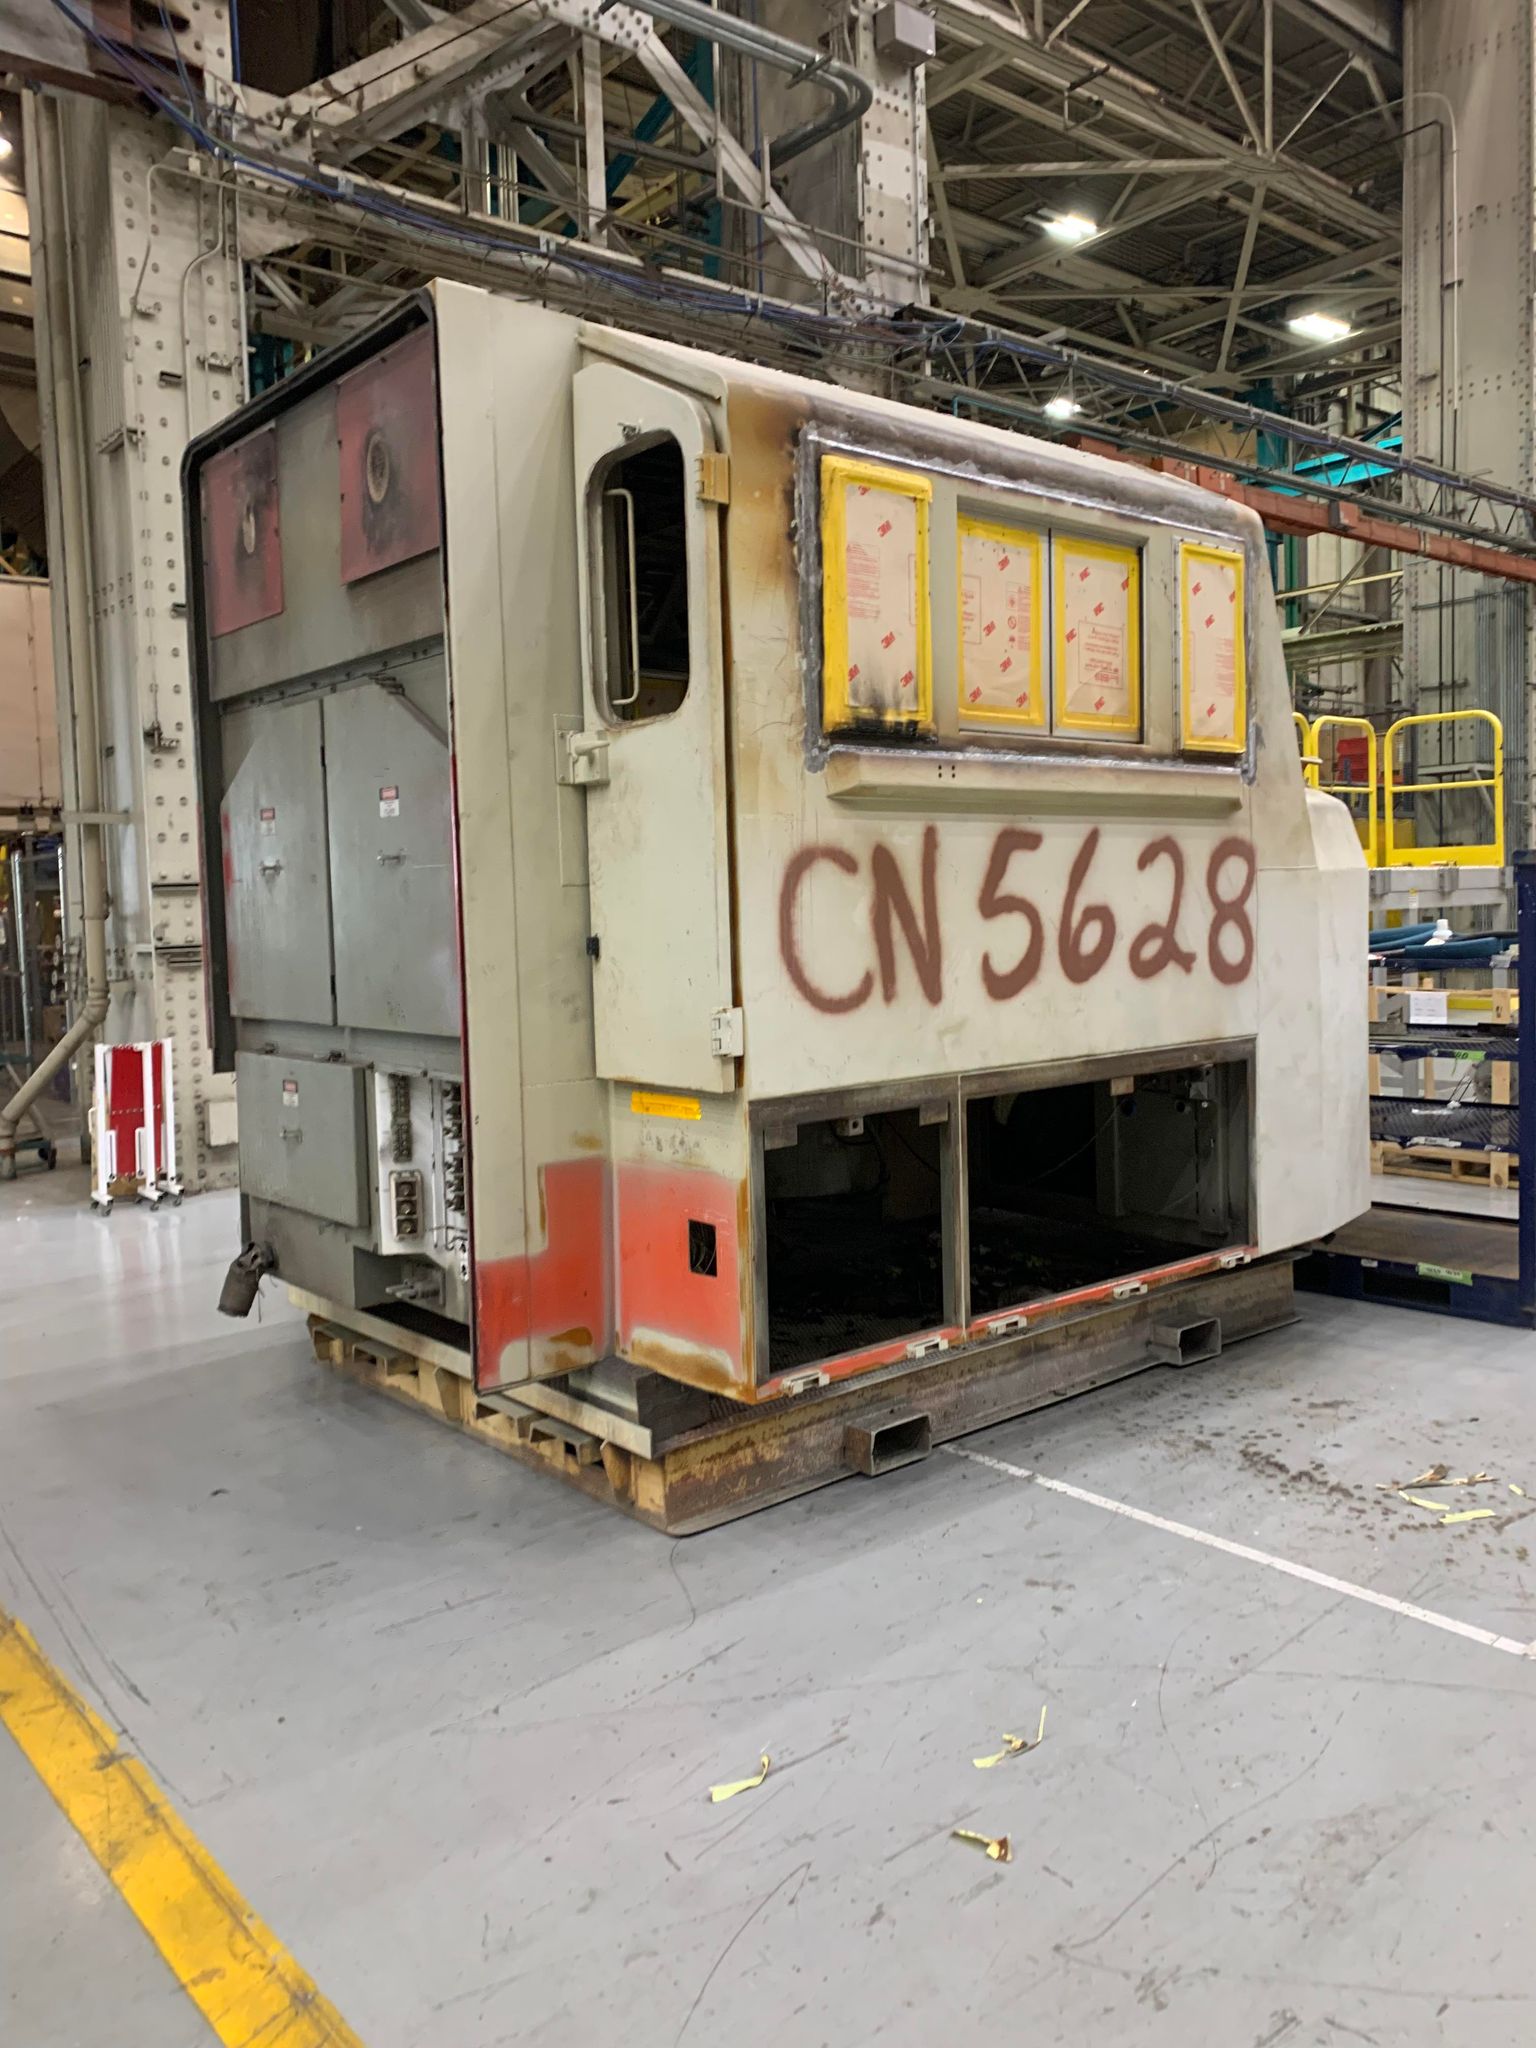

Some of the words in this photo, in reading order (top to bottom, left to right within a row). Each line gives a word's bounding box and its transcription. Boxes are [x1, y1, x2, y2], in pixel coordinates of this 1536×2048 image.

[878, 521, 892, 537] 3M
[881, 631, 896, 648] 3M
[901, 670, 913, 687] 3M
[778, 824, 942, 1014] CN
[977, 825, 1256, 1002] 5628
